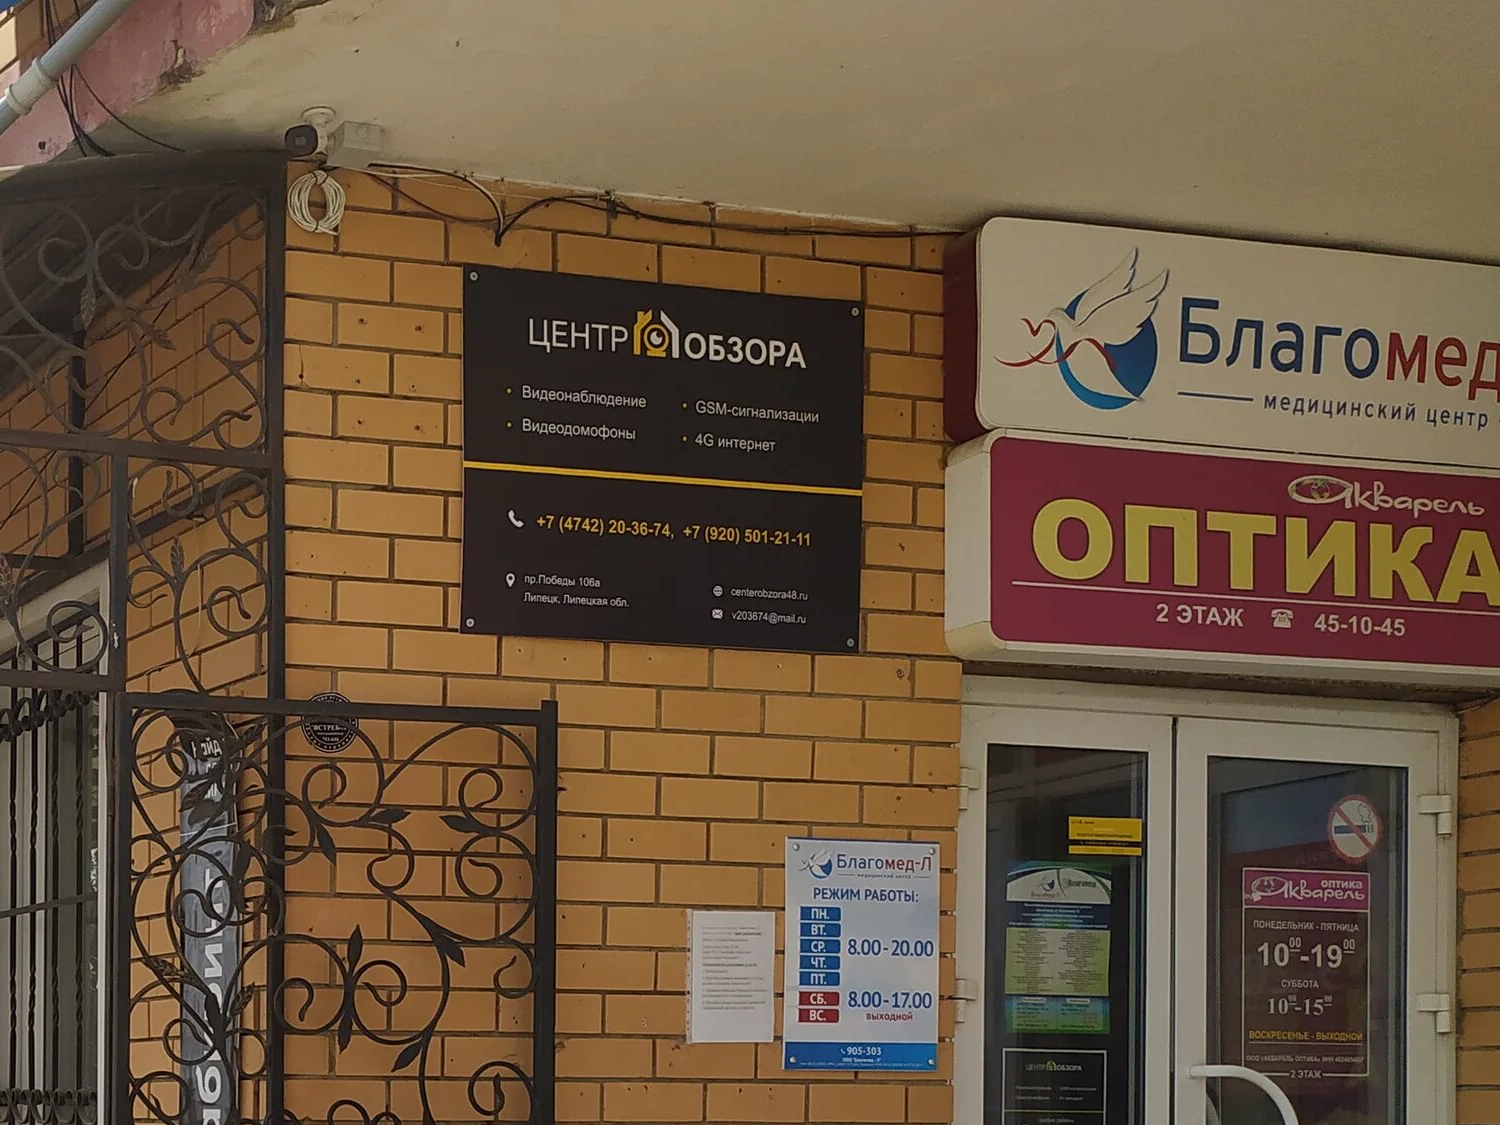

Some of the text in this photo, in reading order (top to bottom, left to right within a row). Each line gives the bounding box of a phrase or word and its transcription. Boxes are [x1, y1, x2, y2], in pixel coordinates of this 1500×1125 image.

[528, 318, 807, 369] ЦЕНТР ОБЗОРА
[521, 385, 647, 409] Видеонаблюдение
[695, 401, 820, 424] GSM-сигнализации
[1264, 393, 1489, 431] медицинский центр
[521, 418, 636, 440] Видеодомофоны
[695, 434, 776, 453] 4G интернет
[536, 515, 811, 548] +7 (4742) 20-36-74, +7 (920) 501-21-11
[1031, 497, 1500, 607] ОПТИКА
[524, 574, 601, 588] пр.Победы 106а
[524, 592, 630, 608] Липецк, Липецкая обл.
[730, 586, 808, 601] centerobzora48.ru
[731, 610, 807, 625] v203674@mail.ru
[1155, 603, 1406, 637] 2 ЭТАЖ 45-10-45
[836, 853, 931, 873] Благомед-Л
[1321, 879, 1363, 890] оптика
[813, 887, 919, 903] РЕЖИМ РАБОТЫ:
[811, 908, 830, 920] ПН.
[811, 924, 827, 936] ВТ.
[1253, 919, 1314, 931] ПОНЕДЕЛЬНИК
[1320, 923, 1359, 933] ПЯТНИЦА
[811, 940, 827, 952] СР.
[811, 957, 827, 969] ЧТ.
[810, 973, 827, 985] ПТ.
[1281, 979, 1319, 989] СУББОТА
[809, 993, 827, 1005] СБ.
[809, 1009, 827, 1021] ВС.
[866, 1011, 913, 1022] выходной
[1249, 1030, 1309, 1041] ВОСКРЕСЕНЬЕ
[1316, 1030, 1363, 1041] ВЫХОДНОЙ
[846, 1046, 882, 1056] 905-303
[1290, 1070, 1322, 1079] 2 ЭТАЖ
